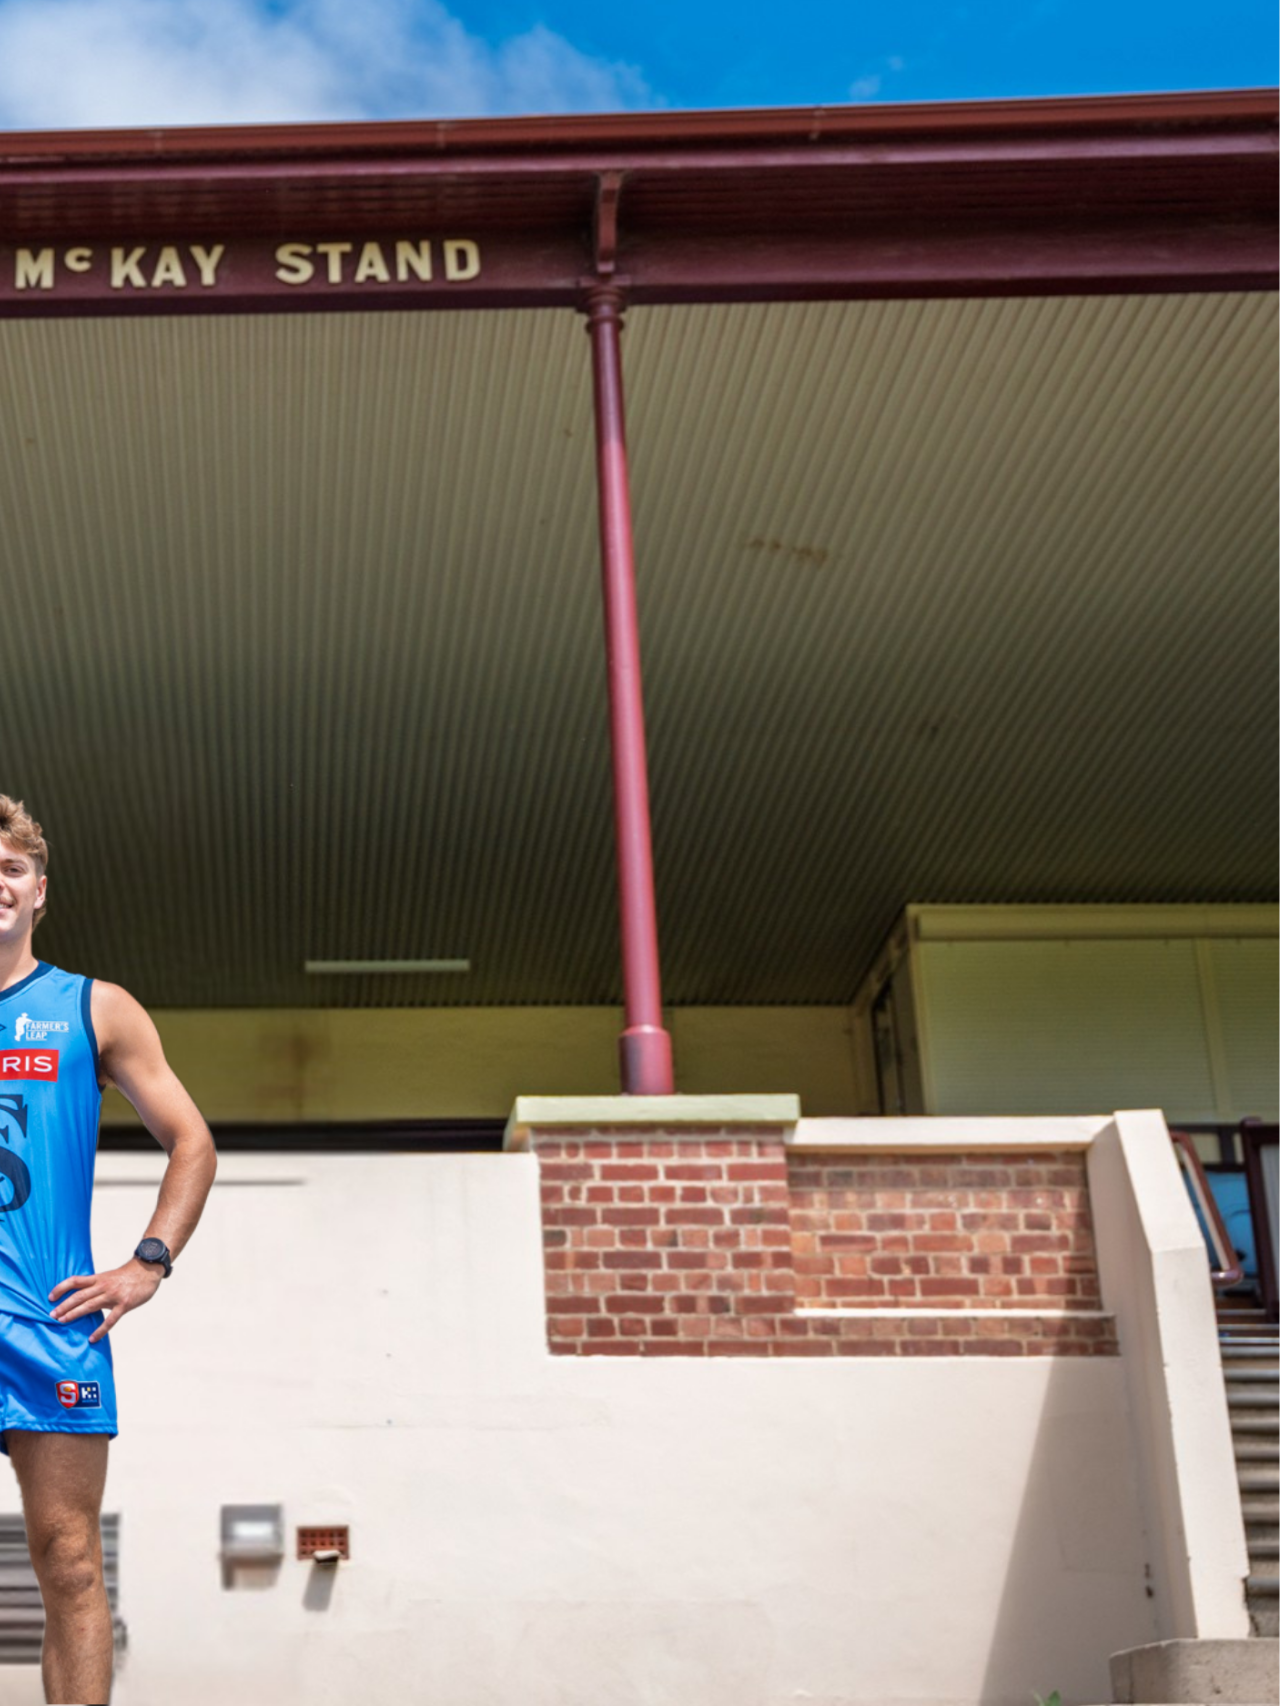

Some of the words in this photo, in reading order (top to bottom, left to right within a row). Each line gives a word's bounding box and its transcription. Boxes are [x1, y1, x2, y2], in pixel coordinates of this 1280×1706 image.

[275, 239, 482, 285] STAND
[25, 1021, 70, 1032] FARMER'S
[25, 1031, 48, 1040] LEAP
